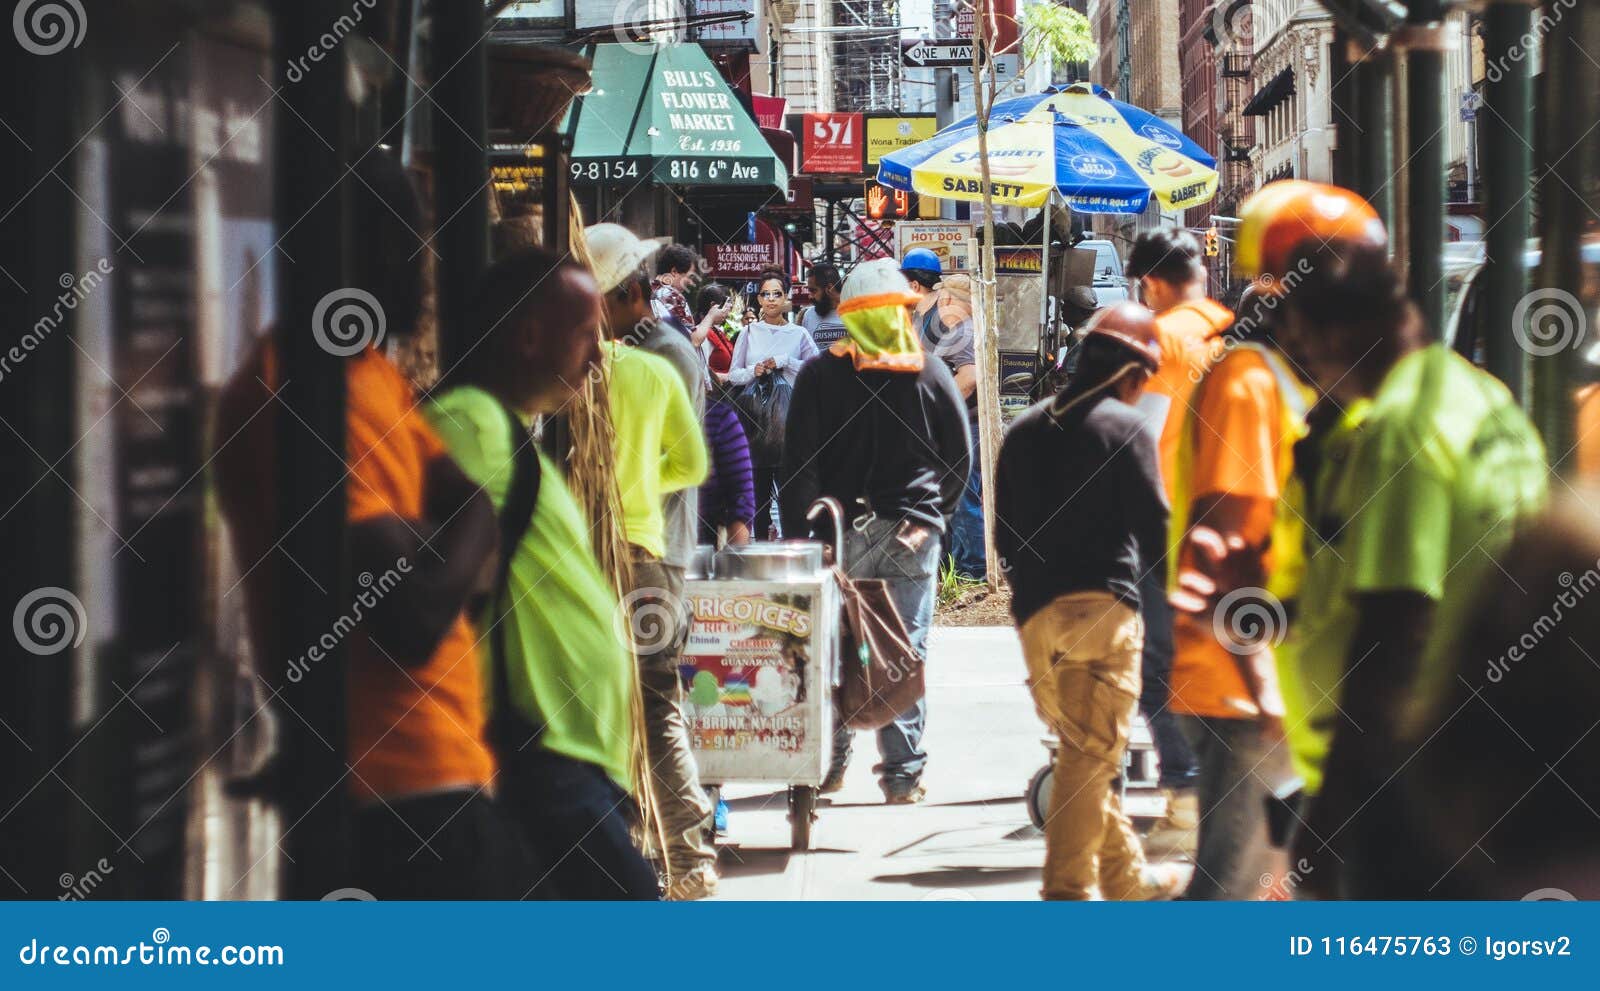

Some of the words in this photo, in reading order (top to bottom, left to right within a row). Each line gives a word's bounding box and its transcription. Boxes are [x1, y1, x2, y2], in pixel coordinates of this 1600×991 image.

[913, 47, 937, 59] ONE
[949, 47, 974, 59] WAY
[663, 70, 716, 88] BILL'S
[661, 92, 731, 110] FLOWER
[669, 113, 735, 131] MARKET
[679, 135, 705, 151] Est.
[710, 138, 742, 152] 1936
[870, 138, 893, 146] Wona
[570, 160, 638, 180] 9-8154
[670, 160, 699, 179] 816
[708, 159, 728, 179] 6th
[731, 162, 759, 179] Ave
[943, 177, 1025, 198] SABETT
[1170, 182, 1208, 204] SABRETT
[1109, 198, 1129, 207] ROLL
[911, 232, 934, 241] HOT
[938, 232, 962, 241] DOG
[741, 244, 771, 252] MOBILE
[717, 253, 759, 262] ACCESSORIES
[814, 331, 850, 340] BUSHMILL
[699, 597, 752, 620] RICO
[755, 604, 811, 635] ICE'S
